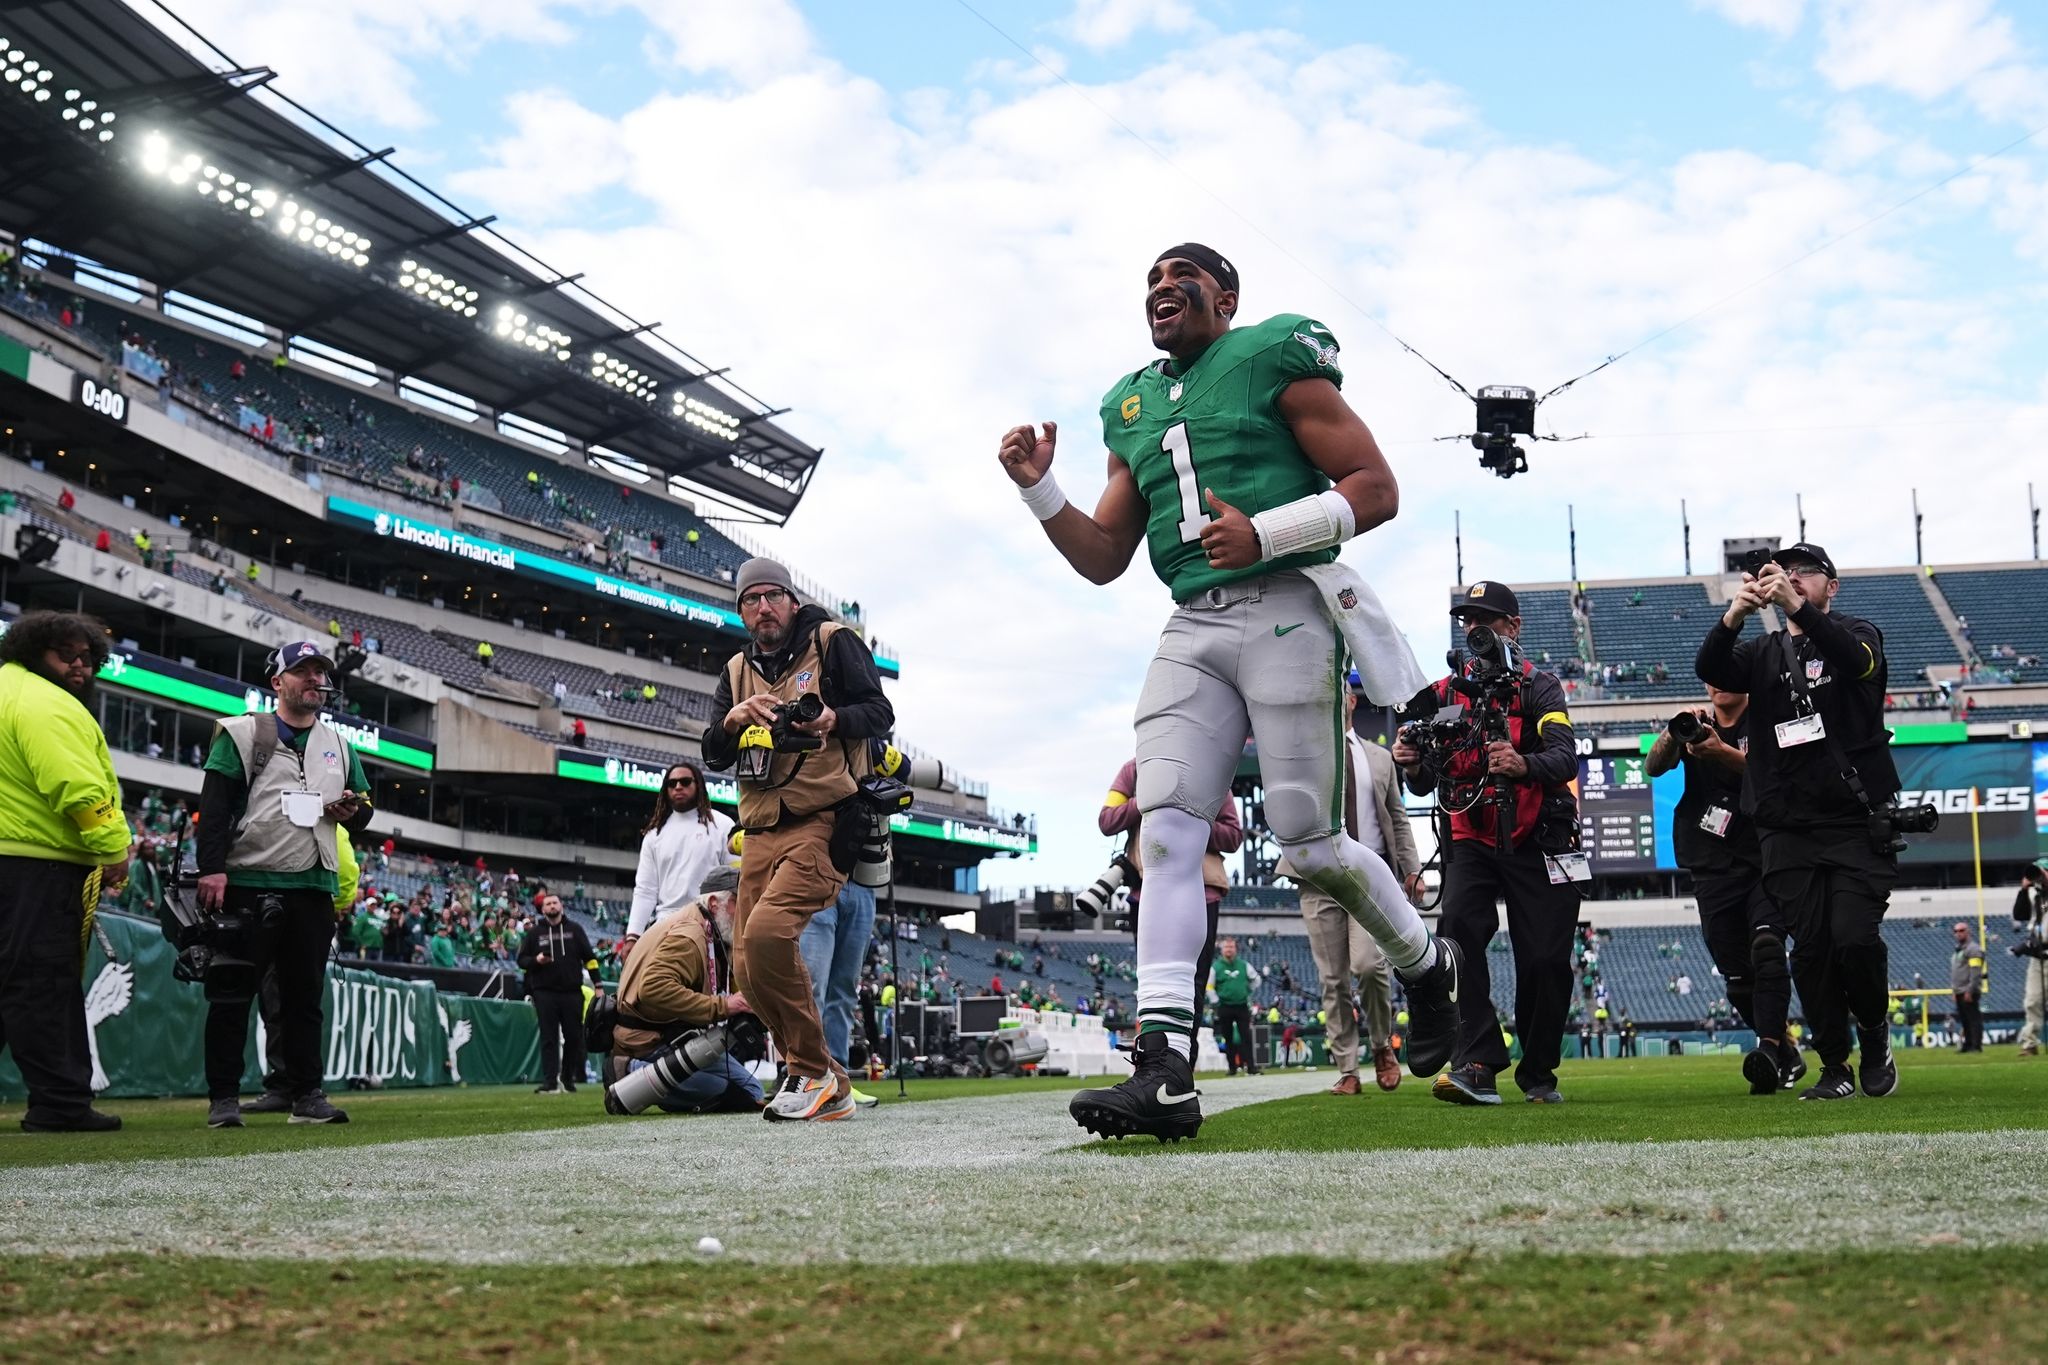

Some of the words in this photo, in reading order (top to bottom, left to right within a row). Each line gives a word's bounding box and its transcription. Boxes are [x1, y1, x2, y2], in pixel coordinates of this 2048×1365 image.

[82, 379, 125, 420] 0:00
[1121, 394, 1141, 420] C
[1160, 419, 1214, 545] 1
[394, 518, 449, 551] Lincoln
[451, 535, 516, 570] Financial
[594, 576, 618, 595] Your
[620, 585, 669, 611] tomorrow.
[669, 598, 688, 616] Our
[623, 762, 667, 790] Lincol
[1587, 771, 1605, 785] 20
[1899, 786, 2031, 814] EAGLES
[323, 978, 416, 1081] BIRDS
